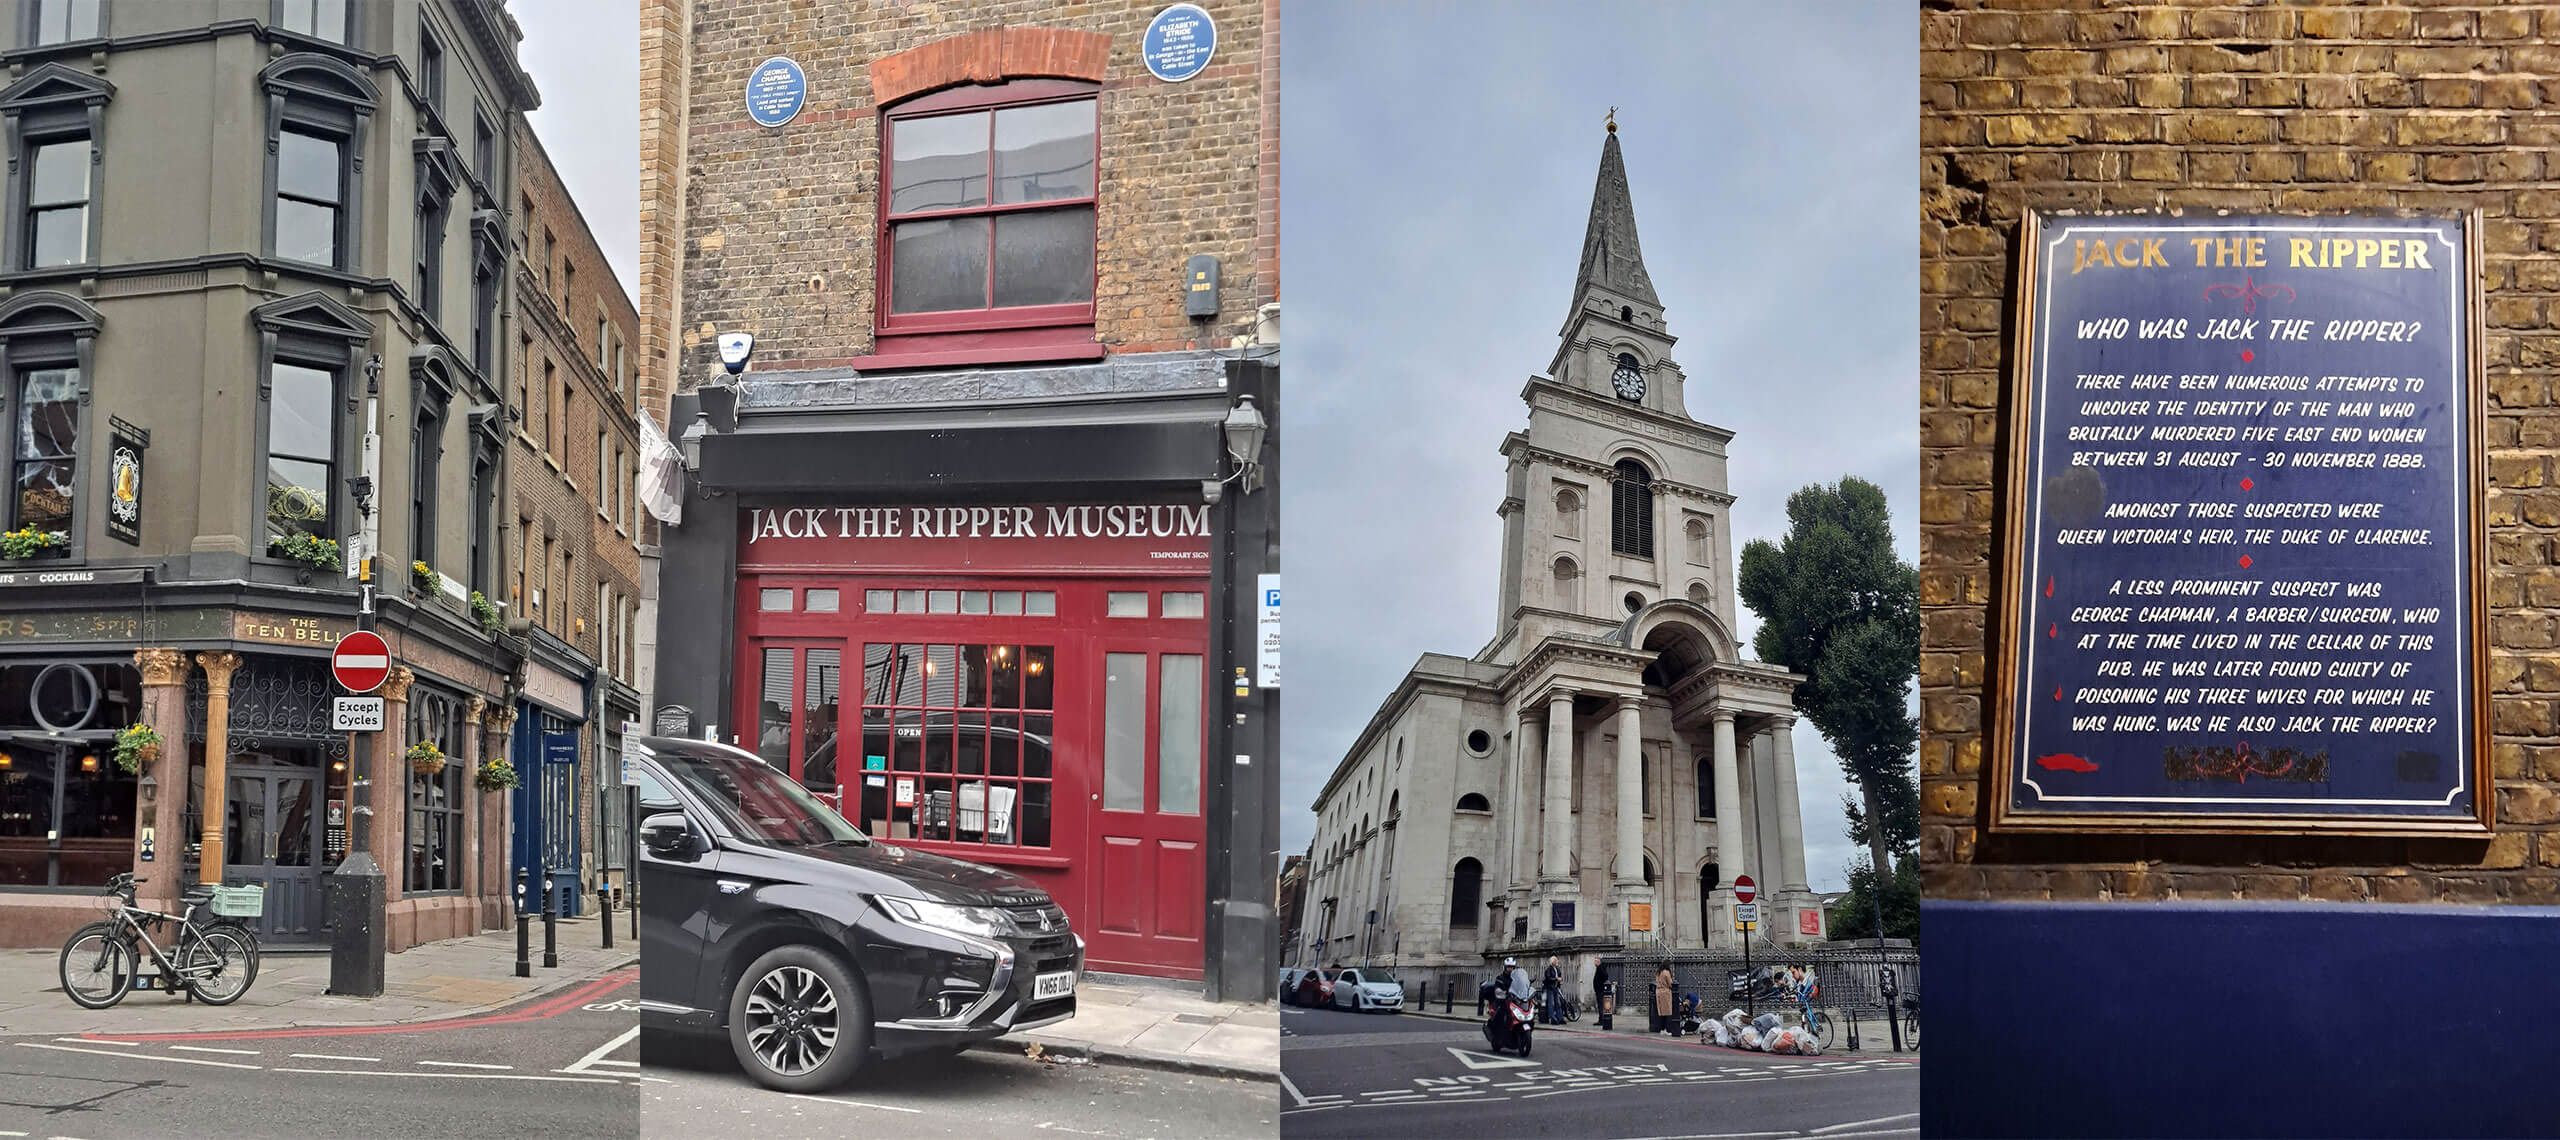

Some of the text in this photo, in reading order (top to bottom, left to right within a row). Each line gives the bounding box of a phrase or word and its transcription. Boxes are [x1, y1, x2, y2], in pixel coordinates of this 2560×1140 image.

[1159, 21, 1199, 32] ELIZABETH
[1166, 28, 1191, 37] STRIDE
[761, 74, 791, 82] CHAPMAN
[764, 68, 788, 76] GEORGE
[2071, 237, 2433, 275] JACK THE RIPPER
[2077, 317, 2422, 343] WHO WAS JACK THE RIPPER?
[2075, 373, 2425, 393] THERE HAVE BEEN NUMEROUS ATTEMPTS TO
[2080, 399, 2416, 419] UNCOVER THE IDENTITY OF THE MAN WHO
[2068, 425, 2428, 444] BRUTALLY MURDERED FIVE EAST END WOMEN
[2071, 451, 2149, 467] BETWEEN
[2153, 450, 2173, 467] 31
[2178, 451, 2242, 468] AUGUST
[2262, 451, 2286, 468] 30
[2290, 451, 2377, 468] NOVEMBER
[2382, 452, 2426, 469] 1888.
[2104, 502, 2384, 519] AMONGST THOSE SUSPECTED WERE
[749, 504, 1212, 545] JACK THE RIPPER MUSEUM
[2056, 528, 2433, 546] QUEEN VICTORIA'S HEIR, THE DUKE OF CLARENCE.
[1150, 551, 1209, 559] TEMPORARY SIGN
[39, 572, 95, 583] COCKTAILS
[2108, 579, 2382, 598] A LESS PROMINENT SUSPECT WAS
[290, 618, 318, 628] THE
[2070, 606, 2441, 625] GEORGE CHAPMAN, A BARBER/SURGEON, WHO
[246, 624, 343, 643] TEN BELL
[2077, 633, 2434, 651] AT THE TIME LIVED IN THE CELLAR OF THIS
[2097, 660, 2413, 678] PUB. HE WAS LATER FOUND GUILTY OF
[2074, 687, 2435, 706] POISONING HIS THREE WIVES FOR WHICH HE
[338, 702, 379, 713] Except
[338, 714, 378, 729] Cycles
[2072, 715, 2438, 733] WAS HUNG. WAS HE ALSO JACK THE RIPPER?
[897, 728, 922, 736] OPEN
[1739, 913, 1755, 921] Cycles
[1413, 1064, 1668, 1087] NO ENTRY
